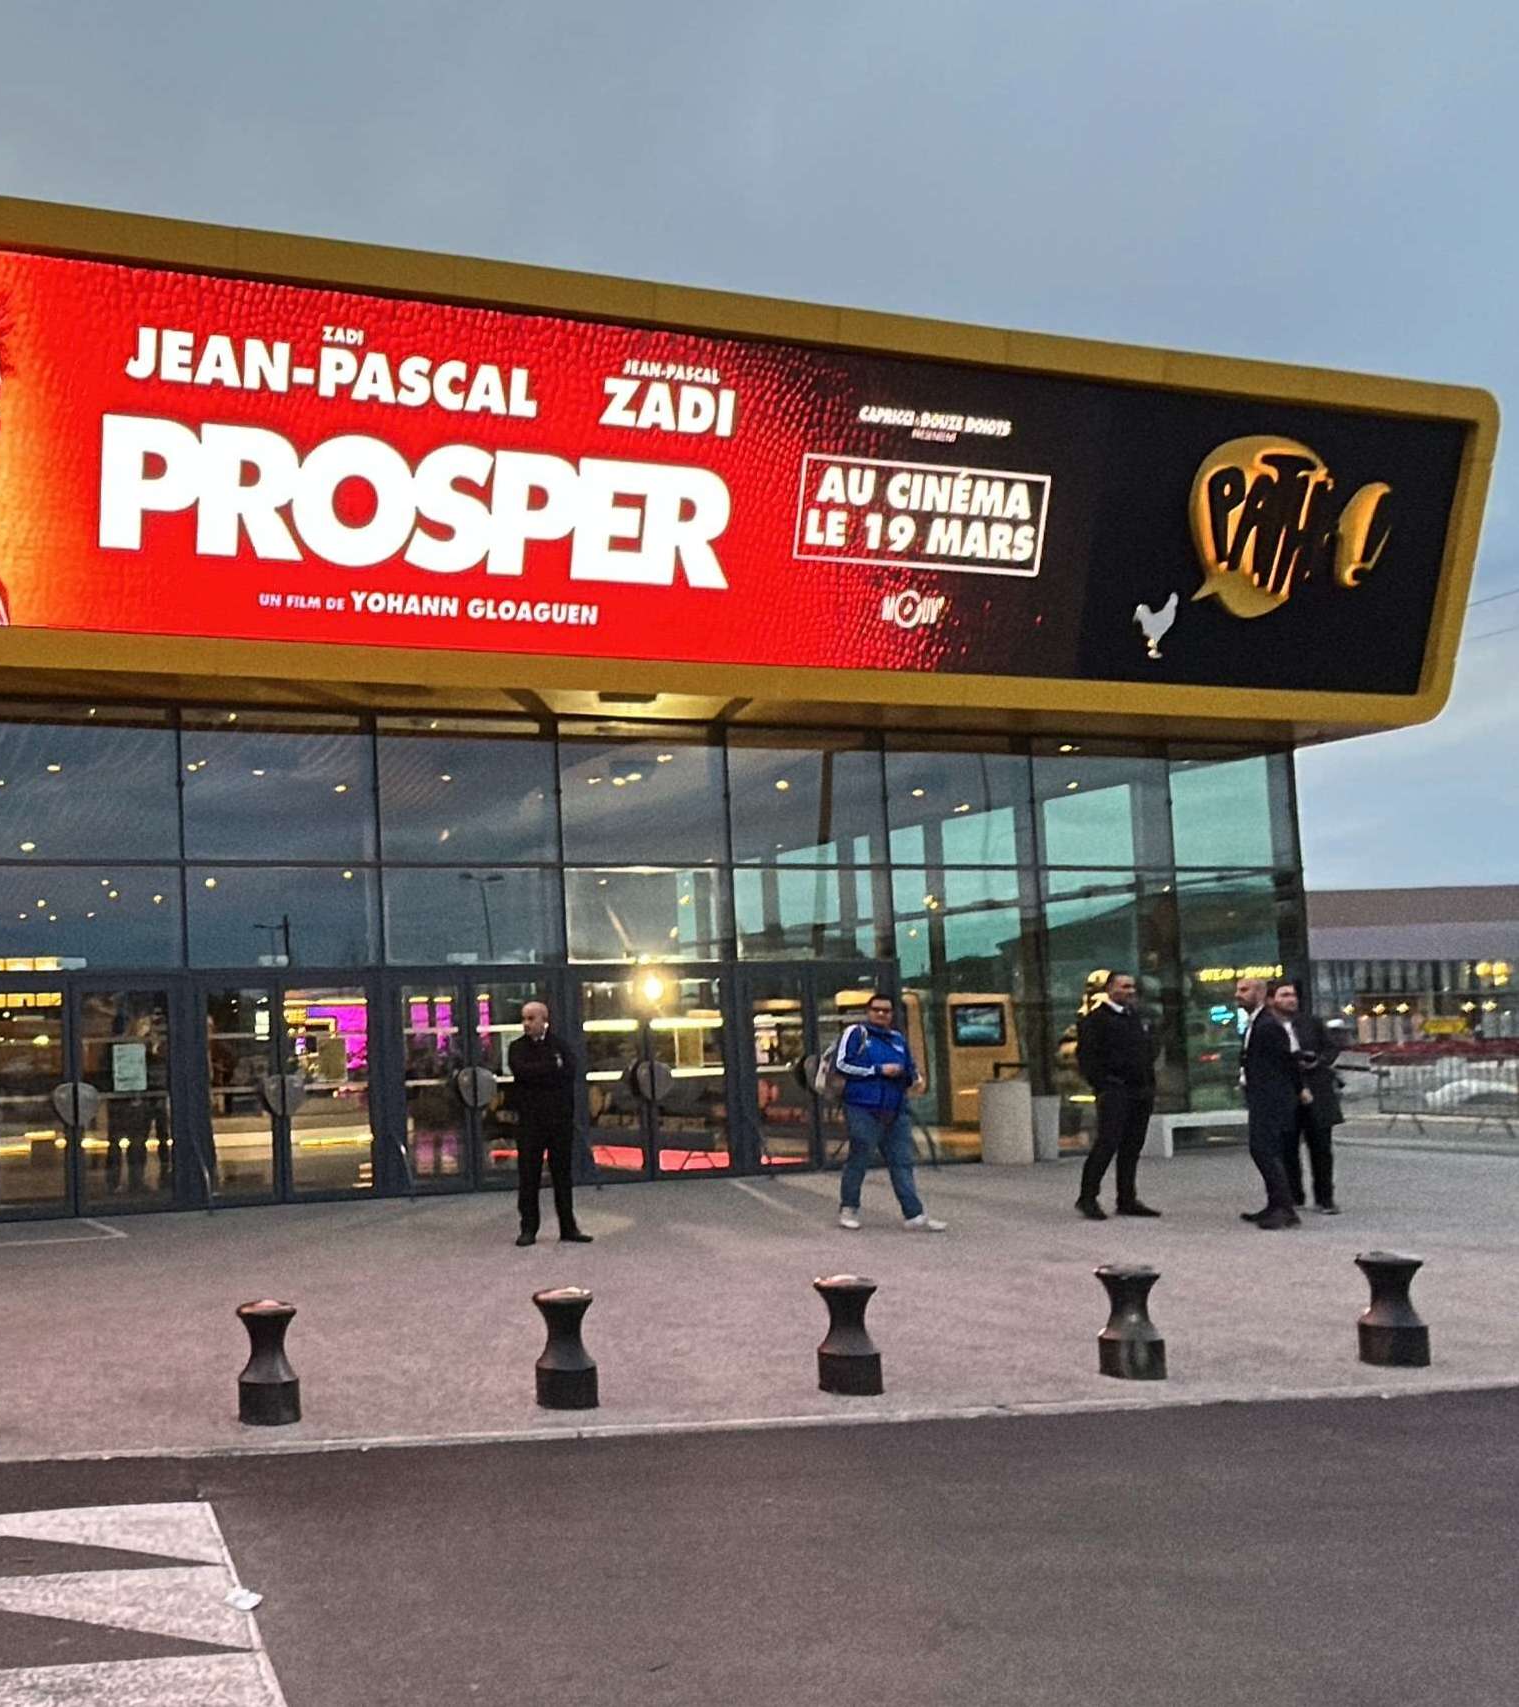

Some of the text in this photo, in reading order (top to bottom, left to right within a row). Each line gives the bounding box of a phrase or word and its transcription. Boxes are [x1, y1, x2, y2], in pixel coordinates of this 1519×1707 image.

[322, 325, 365, 346] ZADI
[126, 326, 538, 418] JEAN-PASCAL
[623, 359, 721, 386] JEAN-PASCAL
[599, 377, 737, 437] ZADI
[98, 412, 731, 589] PROSPER
[816, 466, 1031, 521] AU CINÉMA
[804, 508, 1036, 562] LE 19 MARS
[258, 590, 599, 626] UN FILM DE YOHANN GLOAGUEN
